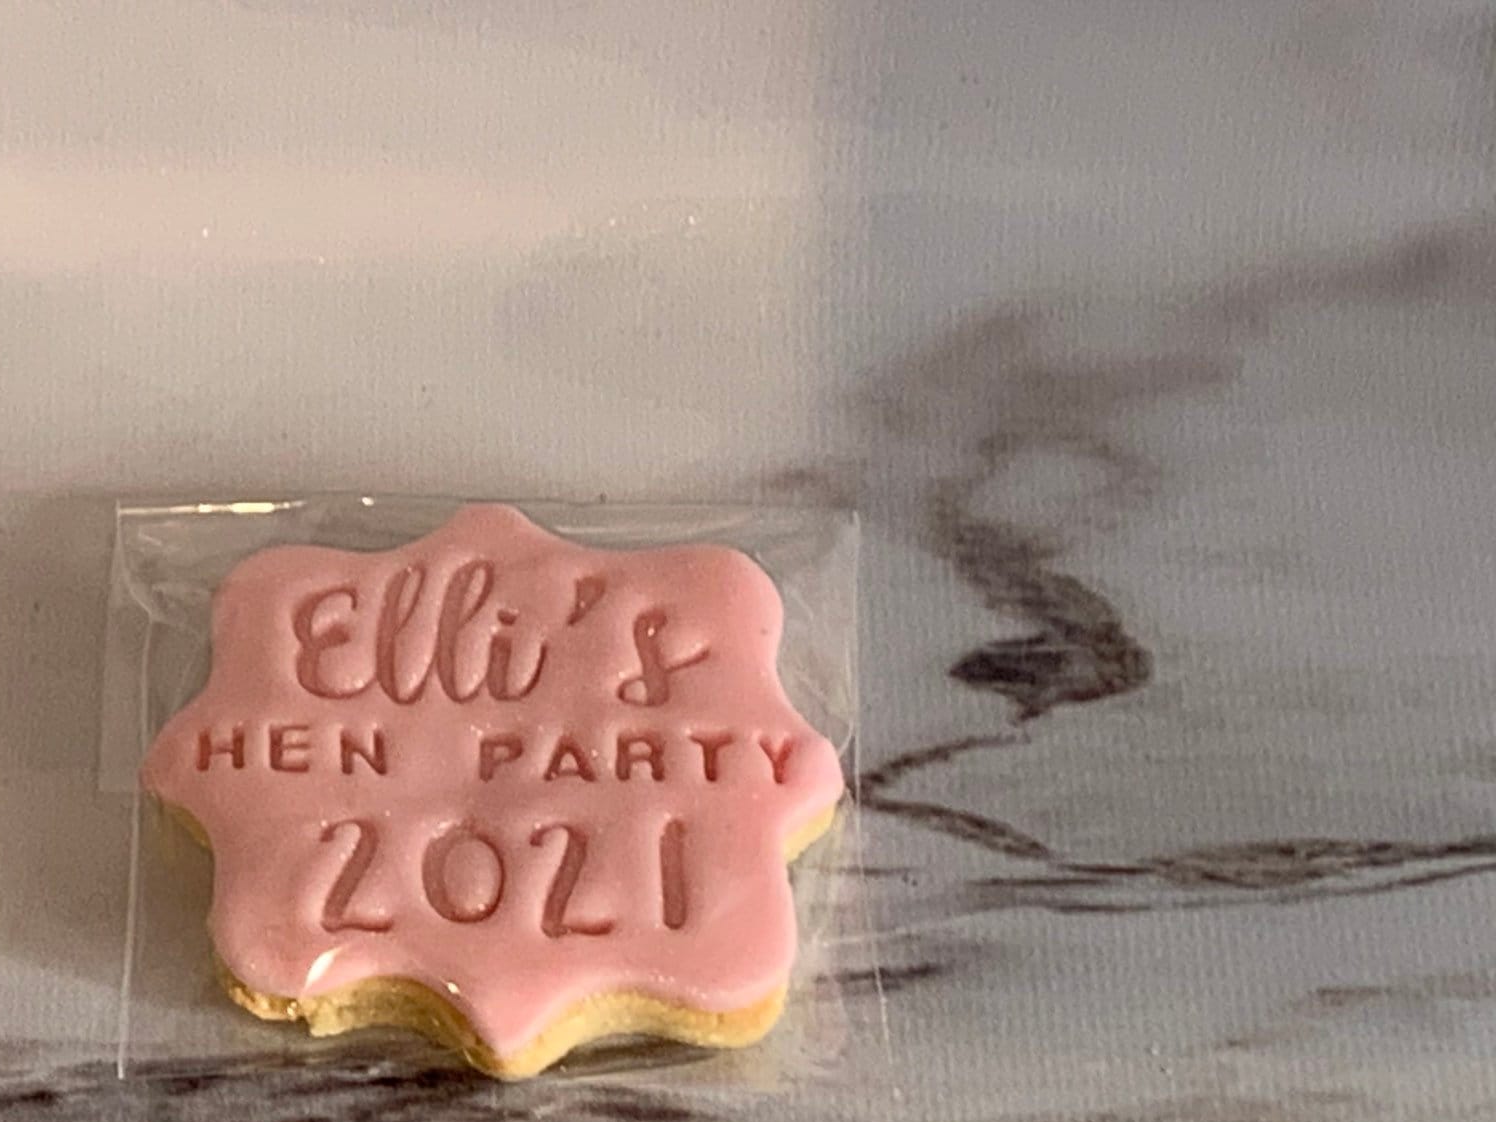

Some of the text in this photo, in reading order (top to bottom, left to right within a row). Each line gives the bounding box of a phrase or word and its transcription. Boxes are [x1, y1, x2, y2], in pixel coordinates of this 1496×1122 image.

[293, 557, 711, 706] Elli's
[195, 722, 797, 785] HEN PARTY
[318, 816, 692, 938] 2021
